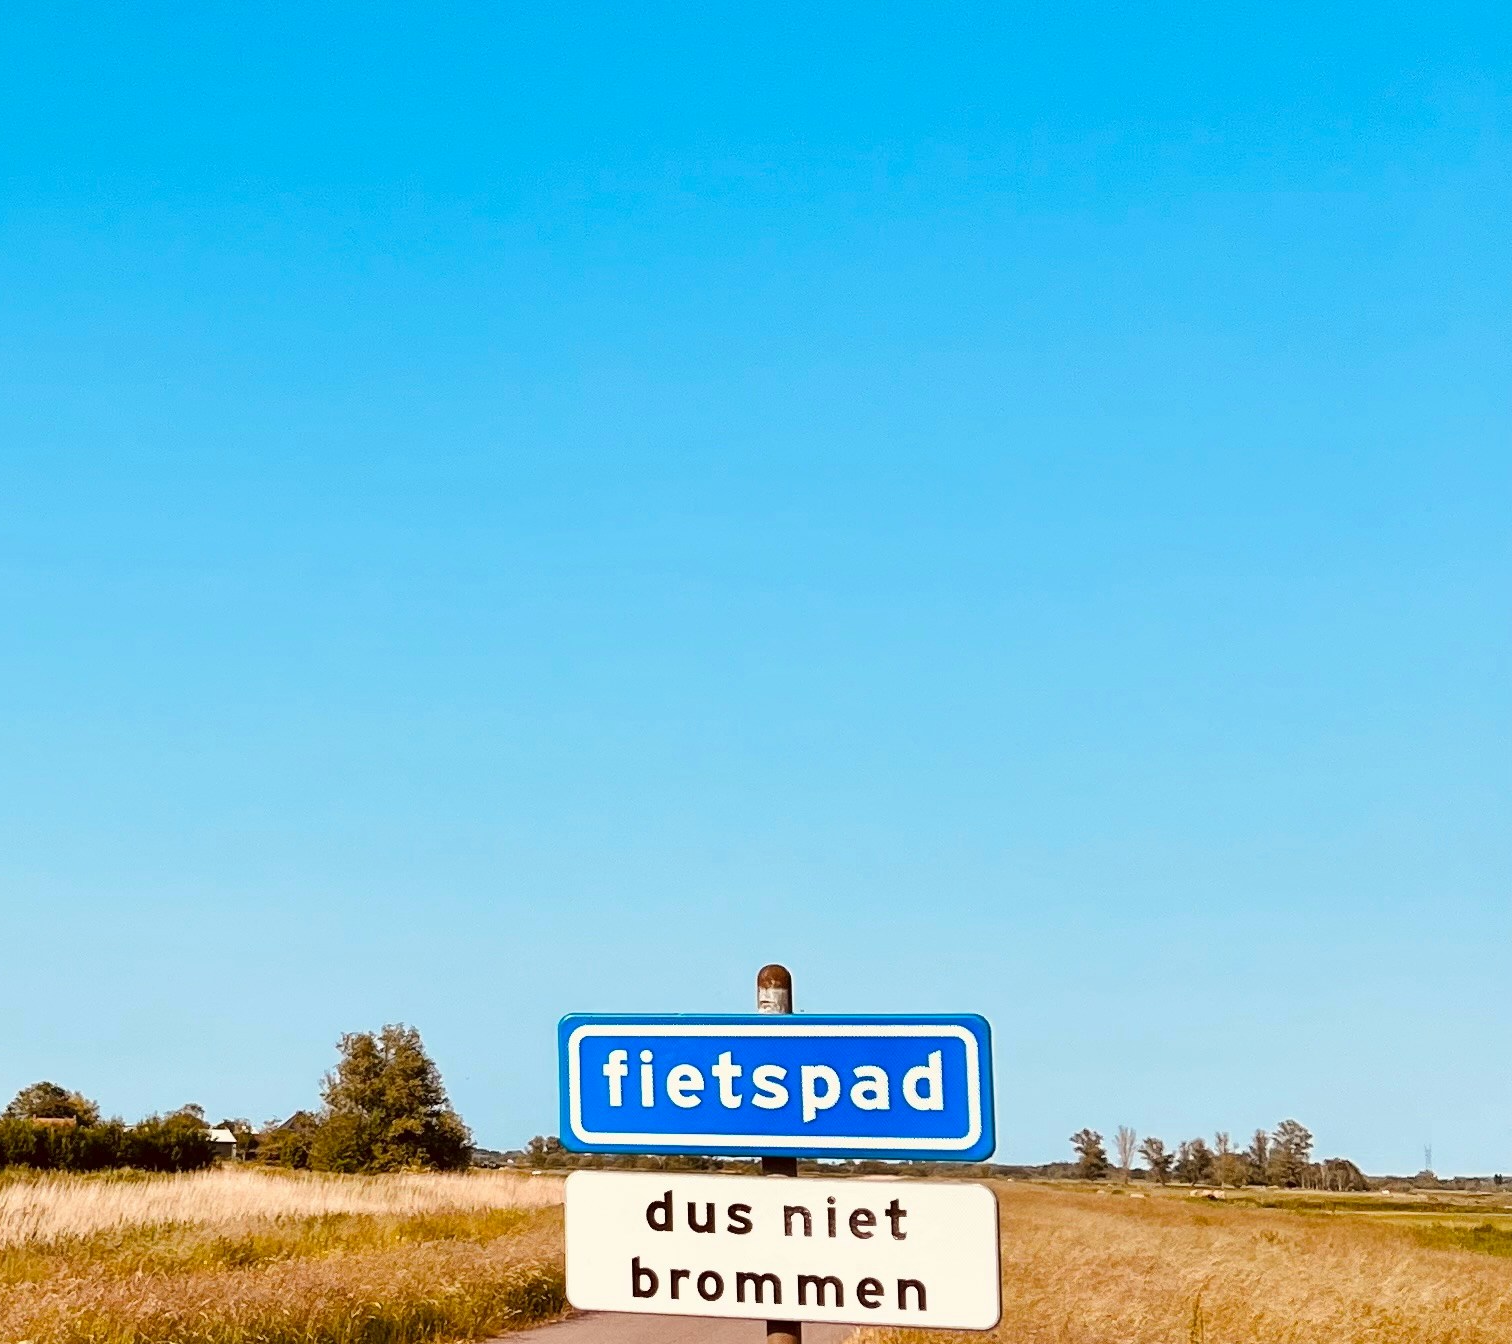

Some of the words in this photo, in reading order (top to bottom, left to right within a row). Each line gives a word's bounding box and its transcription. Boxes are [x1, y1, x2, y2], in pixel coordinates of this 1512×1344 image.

[602, 1049, 945, 1123] fietspad
[645, 1190, 753, 1234] dus
[783, 1196, 908, 1241] niet
[631, 1256, 928, 1312] brommen
